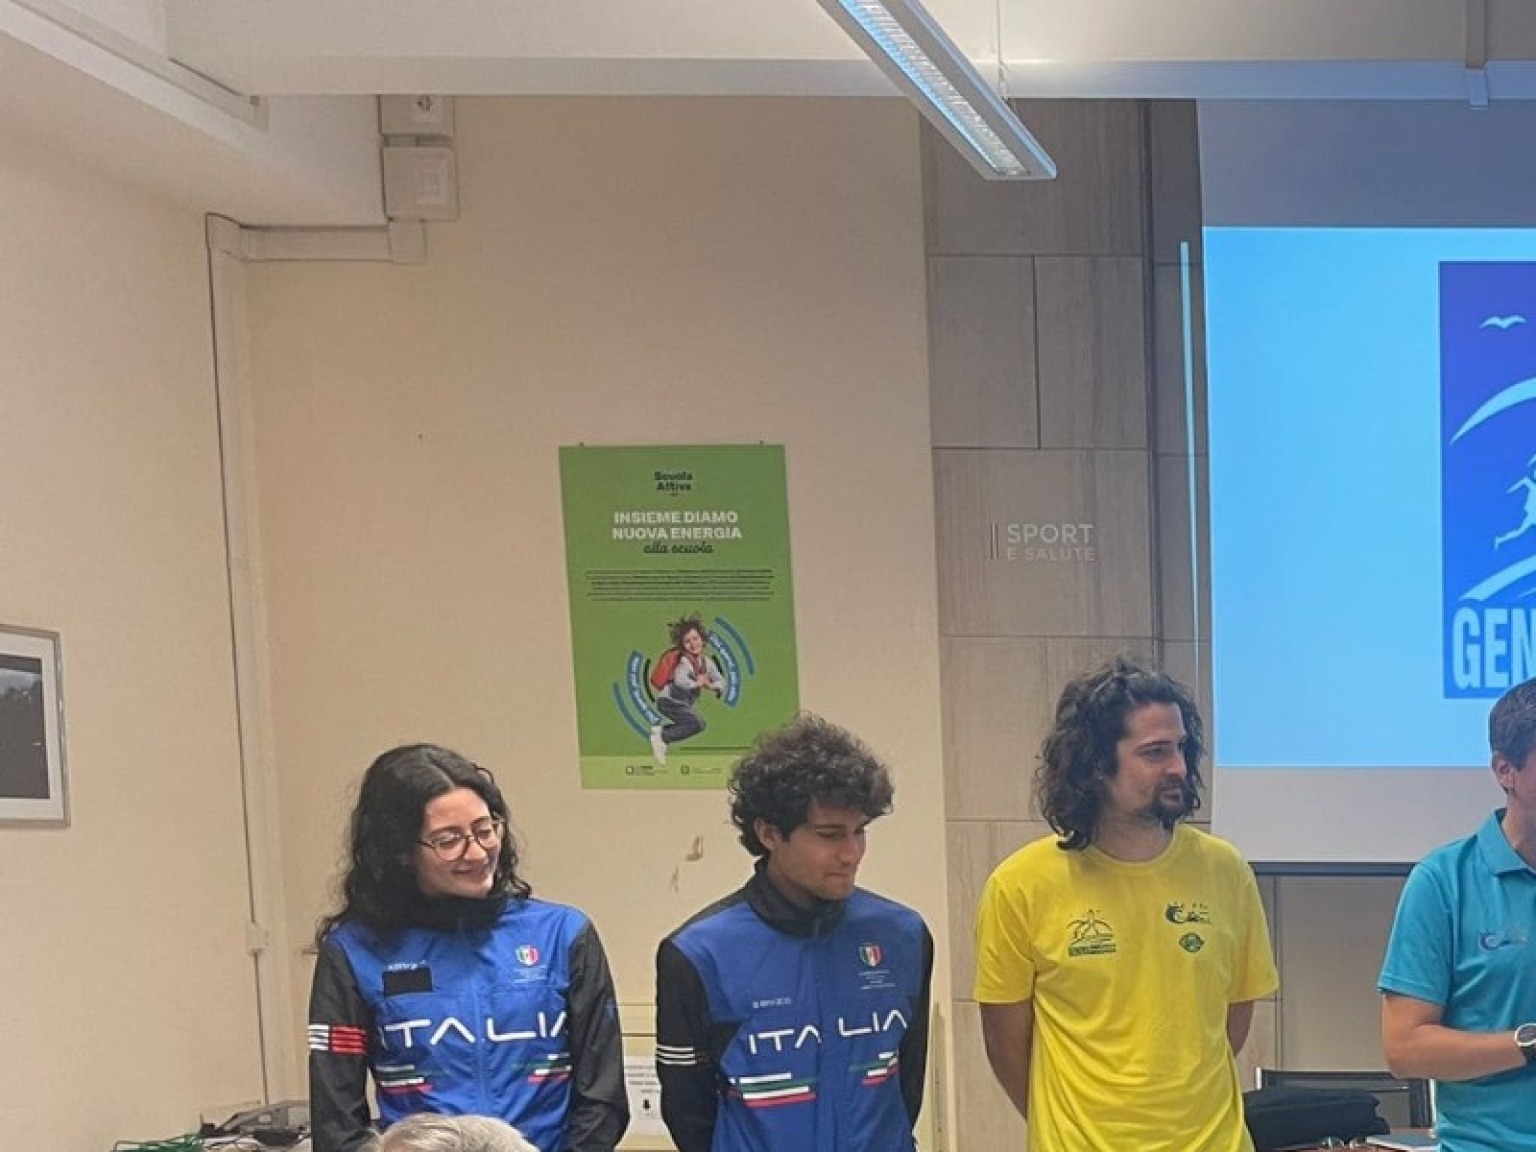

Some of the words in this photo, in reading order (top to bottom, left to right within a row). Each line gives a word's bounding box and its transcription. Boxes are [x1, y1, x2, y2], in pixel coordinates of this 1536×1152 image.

[613, 510, 680, 524] INSIEME
[683, 510, 738, 523] DIAMO
[611, 527, 669, 540] NUOVA
[670, 527, 742, 540] ENERGIA
[1007, 523, 1094, 544] SPORT
[643, 541, 668, 553] alla
[671, 541, 714, 553] scuola
[1007, 549, 1016, 562] E
[1024, 547, 1096, 562] SALUTE
[749, 1009, 908, 1055] ITALIA
